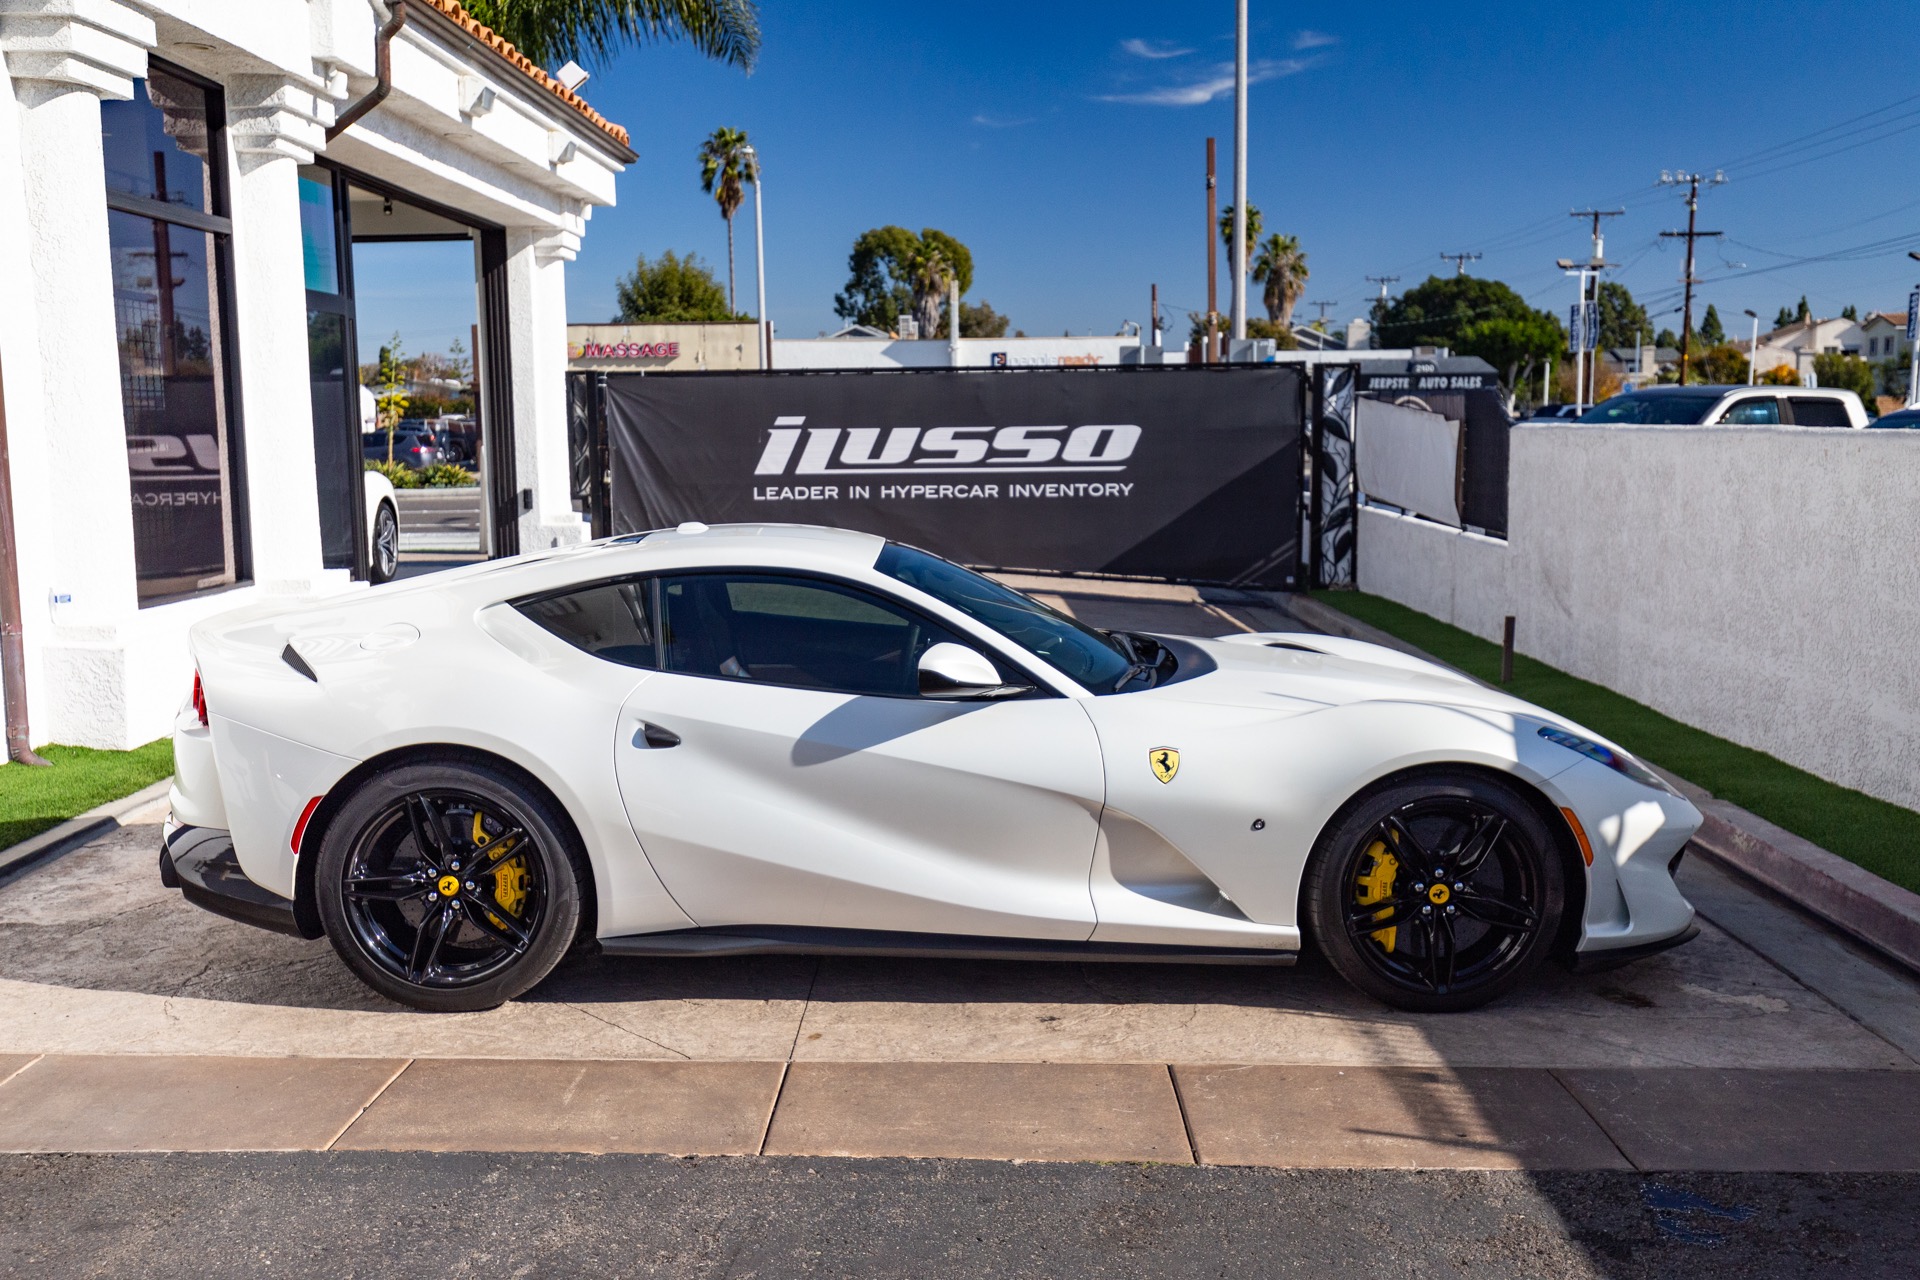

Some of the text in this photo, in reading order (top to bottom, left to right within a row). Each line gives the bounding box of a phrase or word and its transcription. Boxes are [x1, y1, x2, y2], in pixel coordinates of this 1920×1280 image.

[585, 342, 680, 358] MASSAGE
[1418, 377, 1449, 389] AUTO
[1450, 376, 1483, 389] SALES
[753, 482, 1134, 501] LEADER IN HYPERCAR INVENTORY
